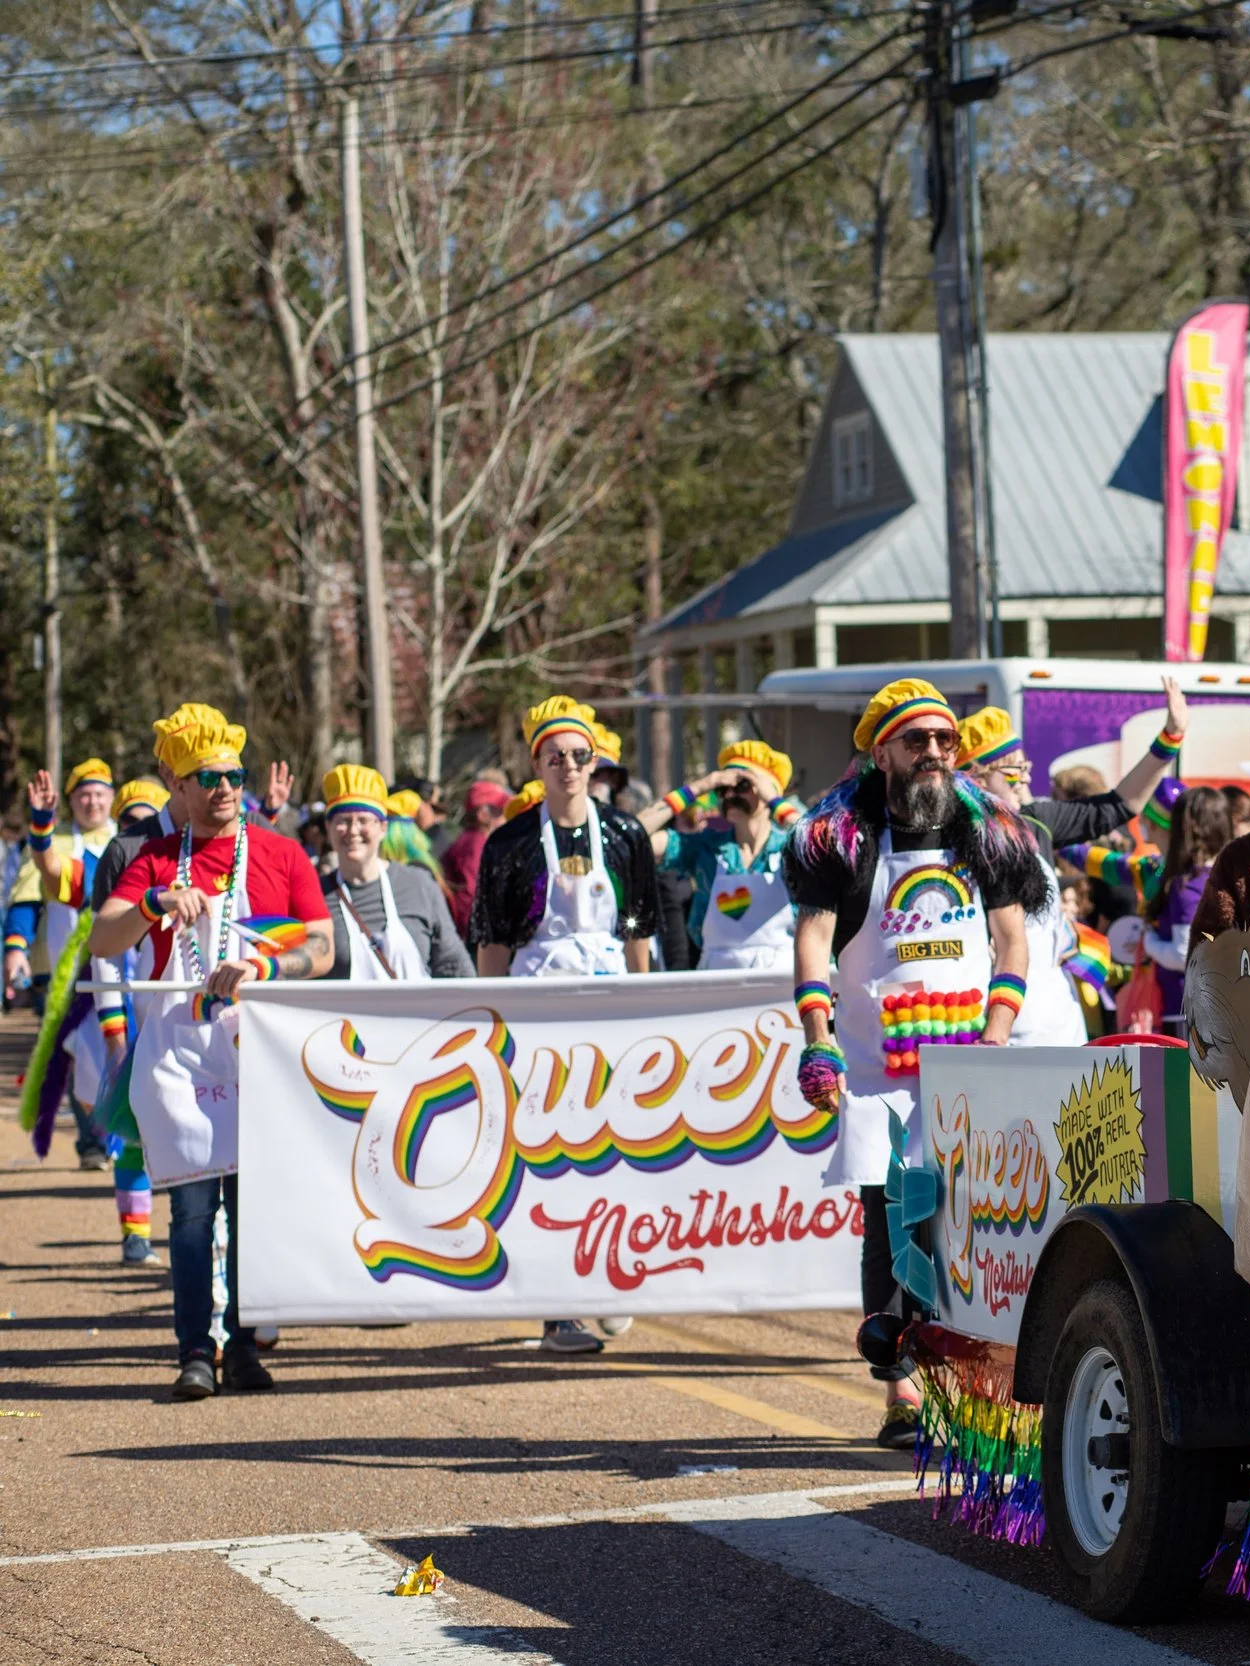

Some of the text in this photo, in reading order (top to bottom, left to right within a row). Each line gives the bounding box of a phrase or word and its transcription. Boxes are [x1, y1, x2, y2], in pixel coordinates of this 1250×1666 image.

[901, 941, 962, 958] BIG FUN
[303, 1006, 839, 1291] Queer
[1061, 1086, 1125, 1143] MADE WITH
[1065, 1114, 1131, 1200] 100% REAL
[931, 1093, 1050, 1305] Queer
[1100, 1149, 1138, 1187] NUTRIA
[530, 1186, 864, 1291] Northshor
